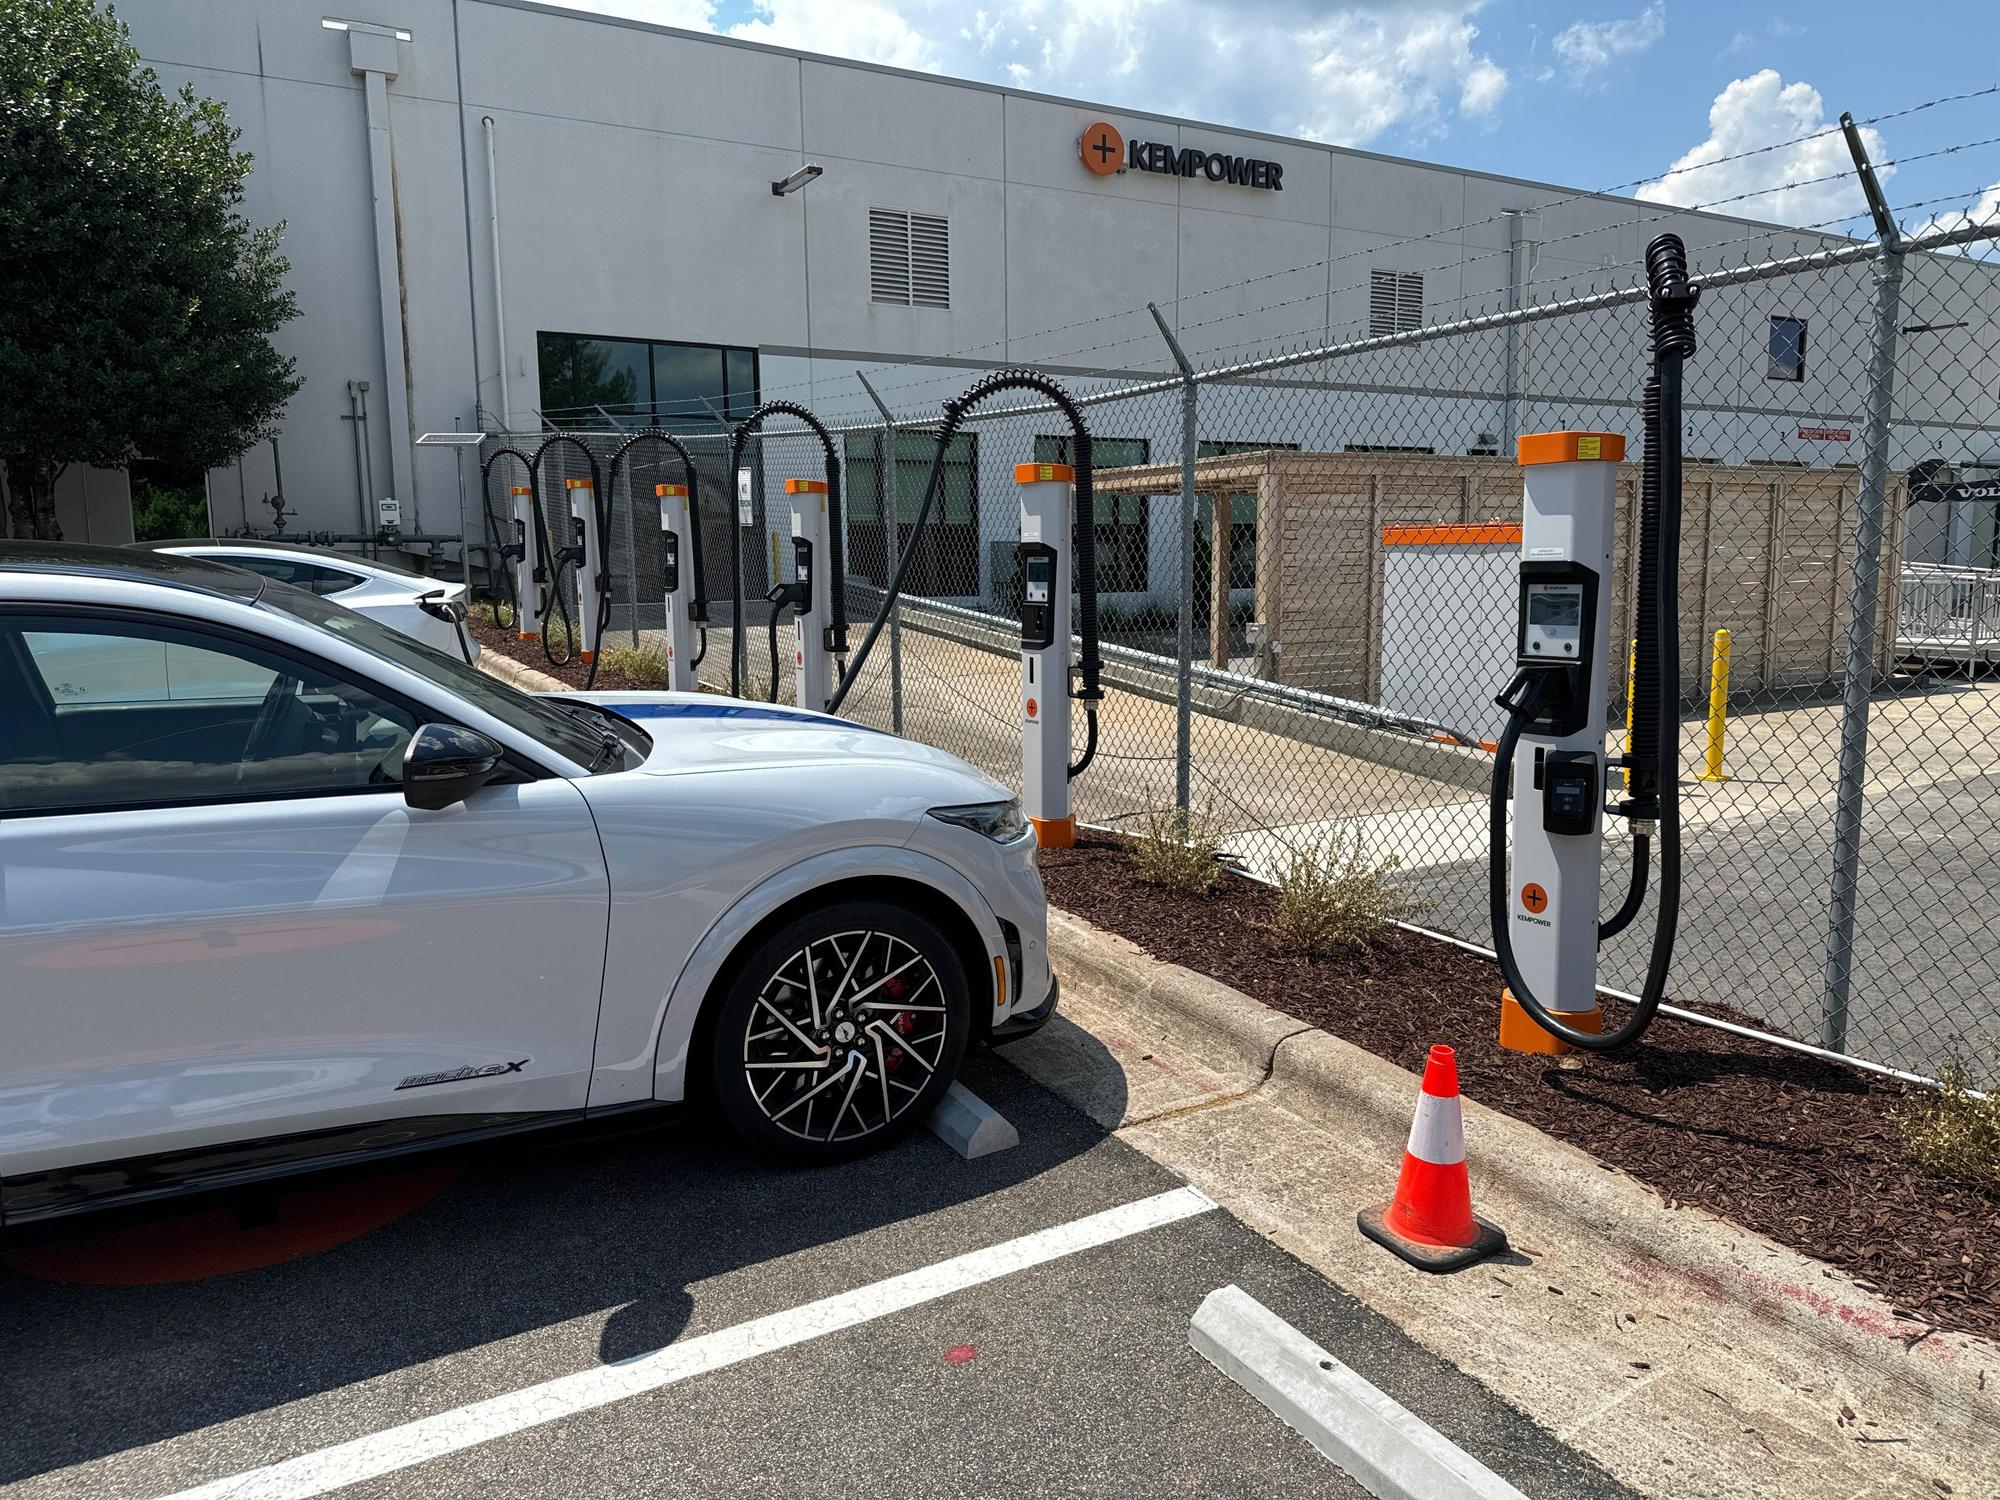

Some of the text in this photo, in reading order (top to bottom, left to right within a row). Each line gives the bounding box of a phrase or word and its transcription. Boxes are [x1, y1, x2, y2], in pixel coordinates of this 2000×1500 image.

[1129, 139, 1284, 191] KEMPOWER
[1687, 426, 1693, 436] 2
[1937, 440, 1943, 449] 5
[1956, 486, 2000, 498] VOL
[1517, 914, 1552, 927] KEMPOWER
